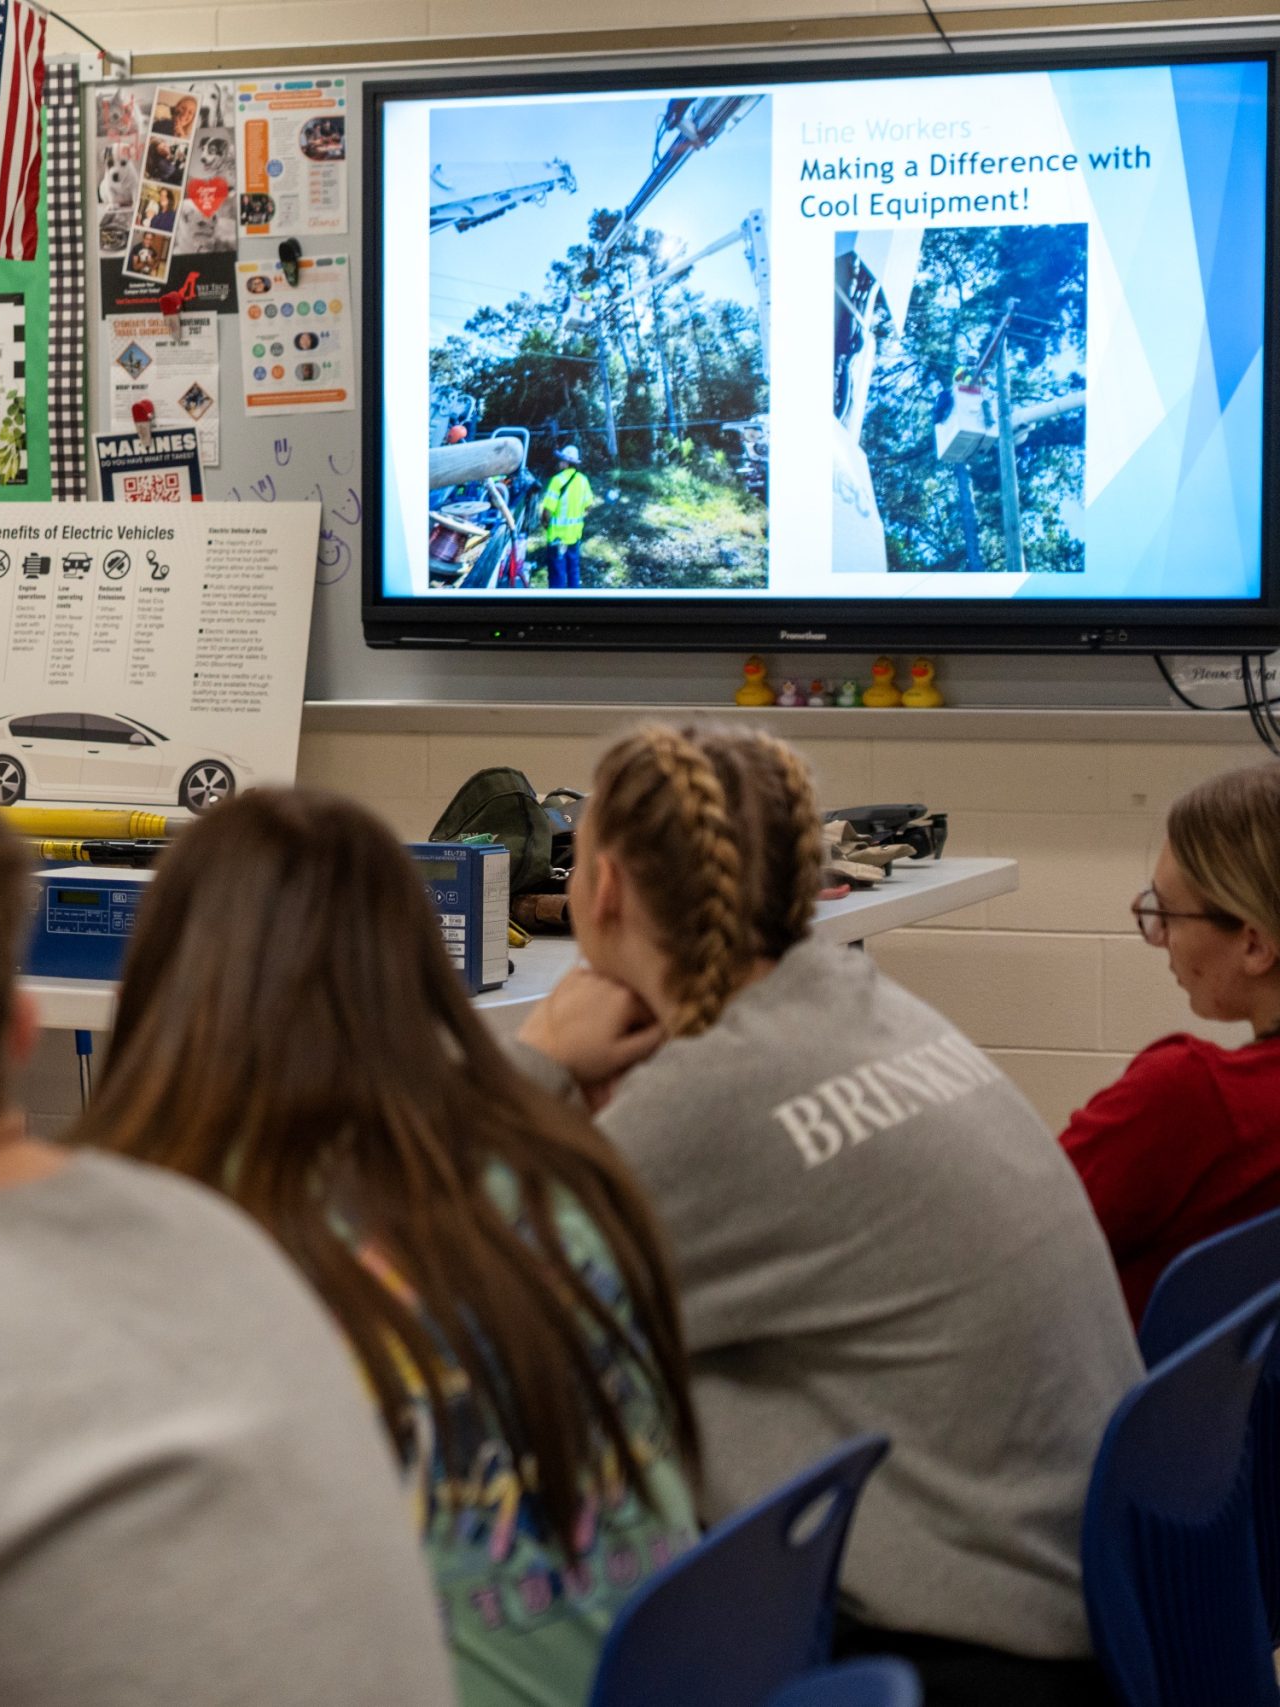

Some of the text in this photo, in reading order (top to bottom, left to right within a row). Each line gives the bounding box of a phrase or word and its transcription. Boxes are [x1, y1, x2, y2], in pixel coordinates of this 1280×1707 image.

[800, 117, 971, 144] Line Workers
[800, 145, 1152, 184] Making a Difference with
[800, 187, 1029, 220] Cool Equipment!
[98, 433, 197, 459] MARINES
[44, 524, 58, 540] of
[62, 525, 114, 540] Electric
[116, 525, 175, 541] Vehicles
